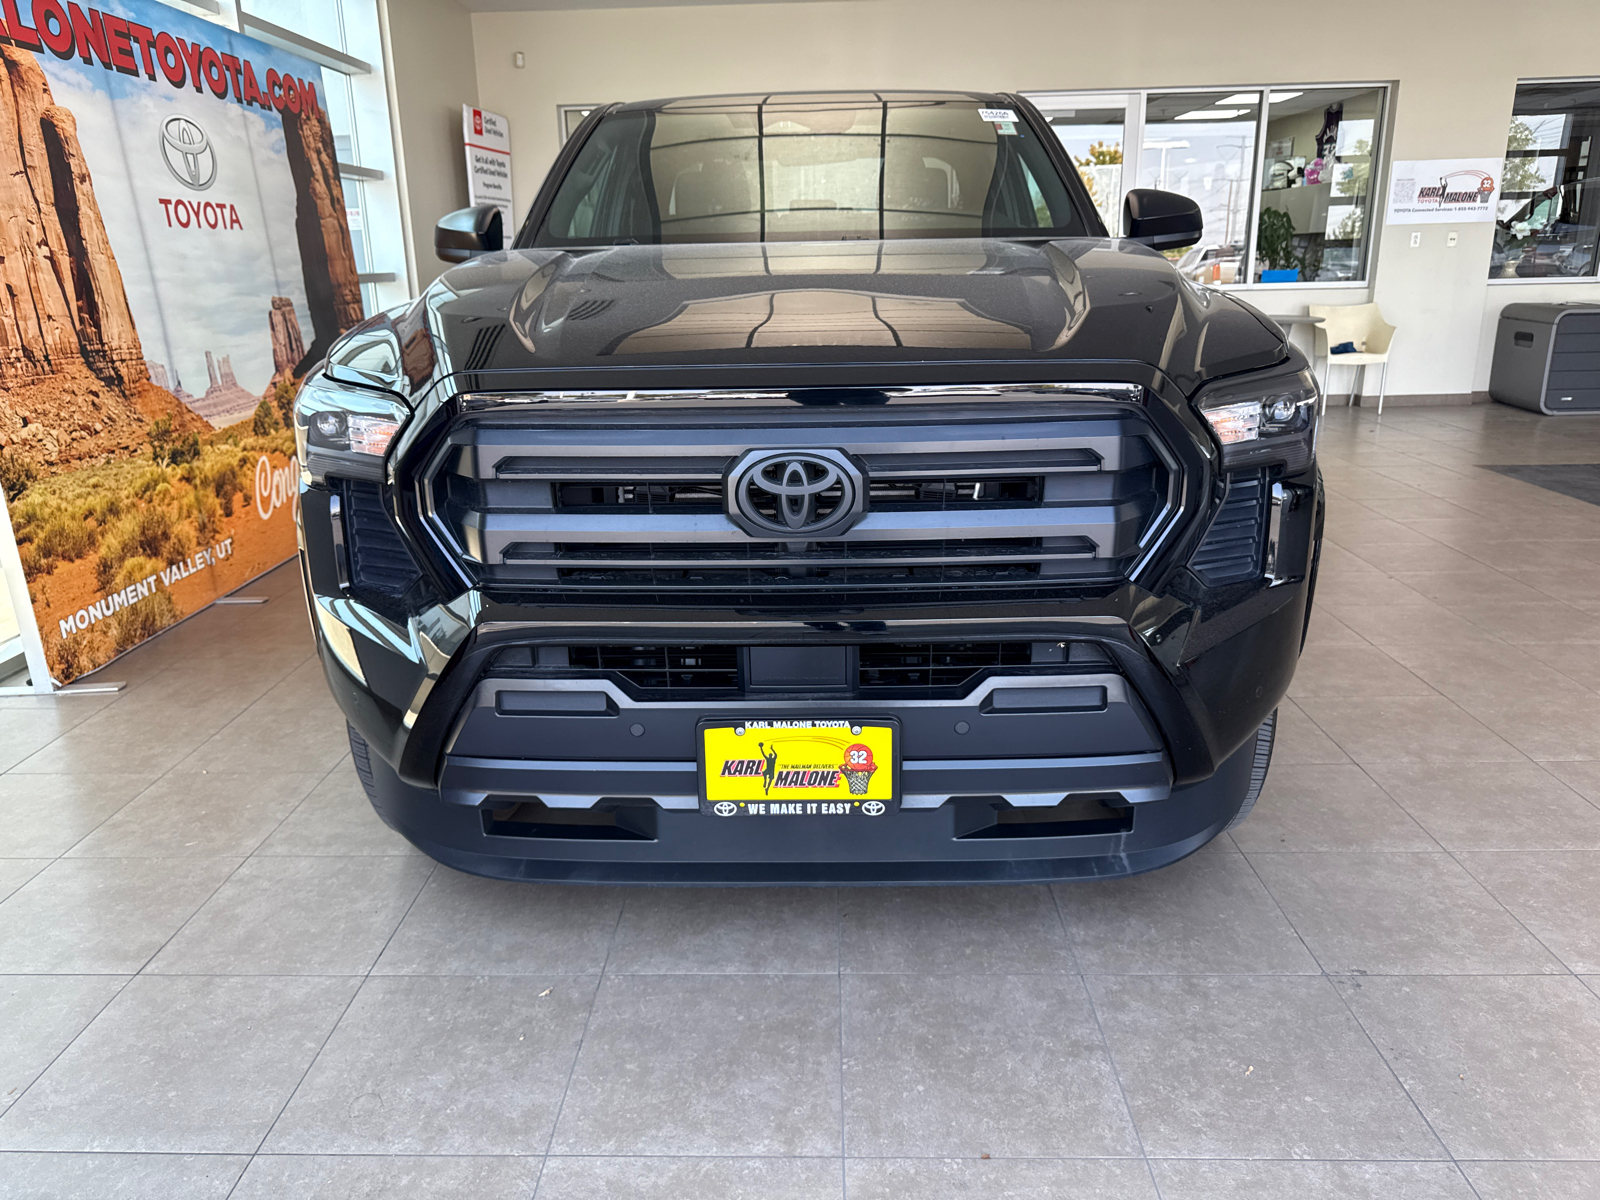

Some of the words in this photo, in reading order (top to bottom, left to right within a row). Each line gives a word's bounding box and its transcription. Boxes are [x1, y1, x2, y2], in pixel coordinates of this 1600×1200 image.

[0, 0, 321, 119] LONETOYOTA.COM
[1483, 180, 1491, 188] 32
[1418, 187, 1441, 199] KARL
[1444, 191, 1480, 204] MALONE
[159, 198, 243, 231] TOYOTA
[59, 575, 157, 639] MONUMENT
[160, 548, 216, 588] VALLEY,
[217, 538, 234, 564] UT
[745, 721, 771, 729] KARL
[773, 721, 812, 729] MALONE
[850, 750, 867, 764] 32
[720, 759, 764, 777] KARL
[774, 769, 842, 788] MALONE
[748, 803, 766, 815] WE
[770, 803, 803, 815] MAKE
[807, 803, 817, 815] IT
[822, 803, 851, 815] EASY
